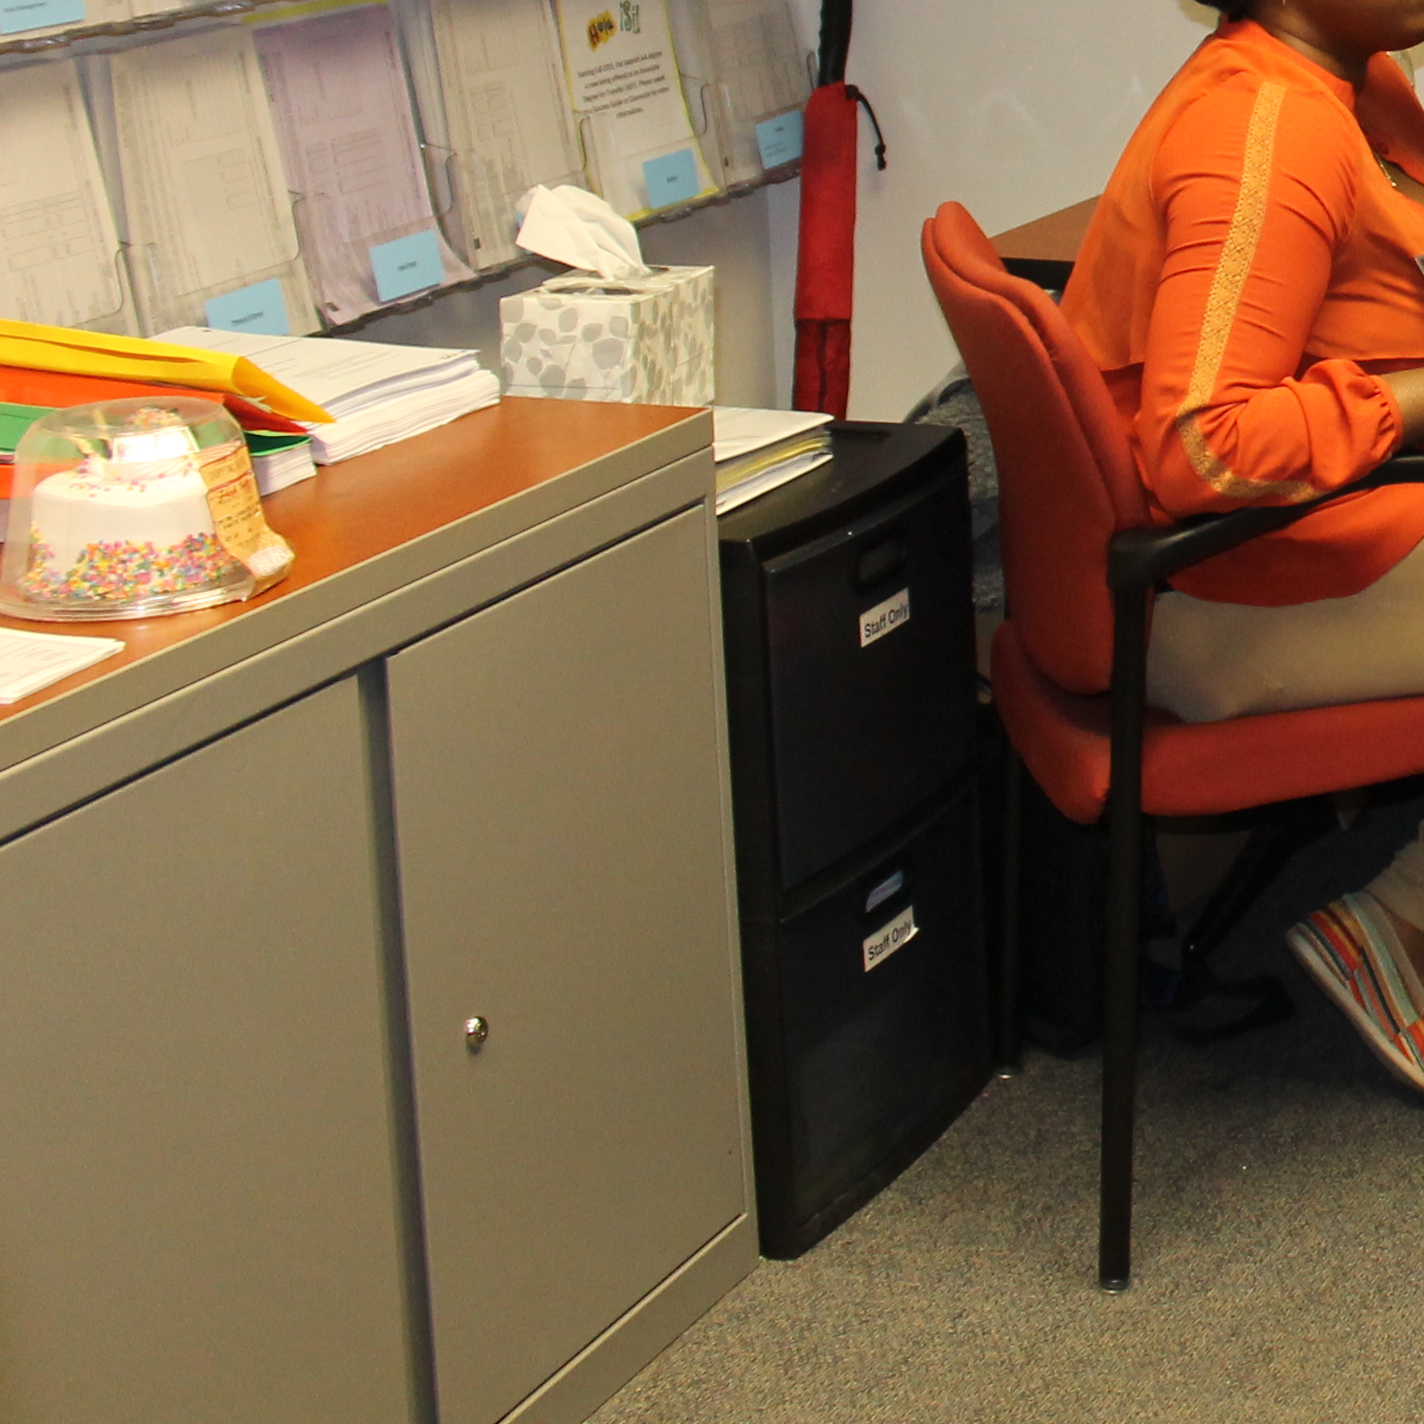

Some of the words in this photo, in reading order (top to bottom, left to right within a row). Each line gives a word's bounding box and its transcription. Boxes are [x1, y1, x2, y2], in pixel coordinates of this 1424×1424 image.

[864, 612, 887, 638] Staff
[888, 602, 909, 624] Only
[868, 933, 890, 961] Staff
[891, 920, 912, 943] Only
